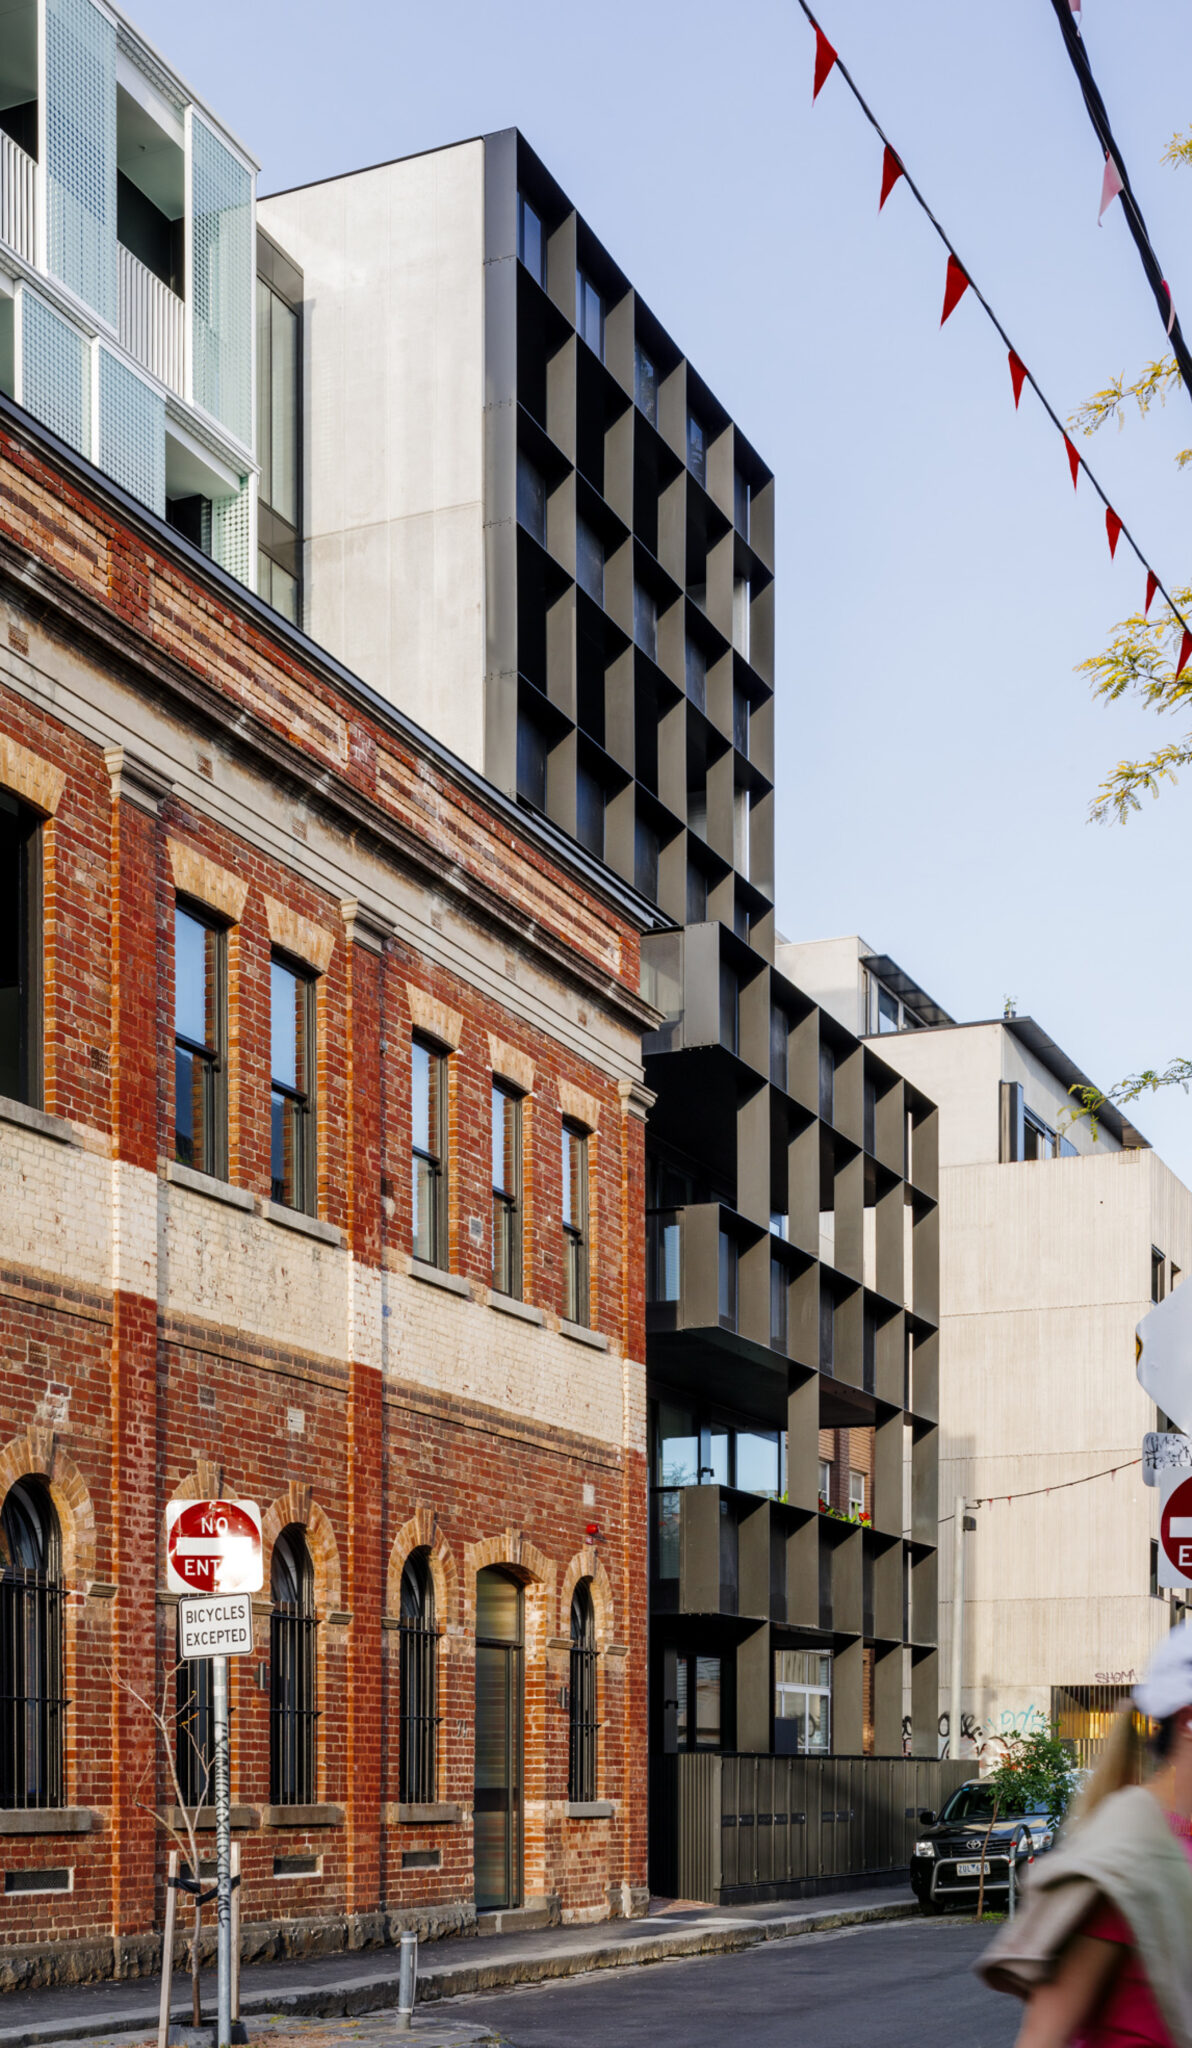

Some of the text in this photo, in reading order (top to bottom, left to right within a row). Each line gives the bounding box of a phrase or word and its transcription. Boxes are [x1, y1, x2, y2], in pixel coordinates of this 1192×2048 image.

[201, 1516, 229, 1535] NO
[184, 1559, 221, 1576] ENT
[186, 1605, 245, 1624] BICYCLES
[186, 1628, 247, 1646] EXCEPTED
